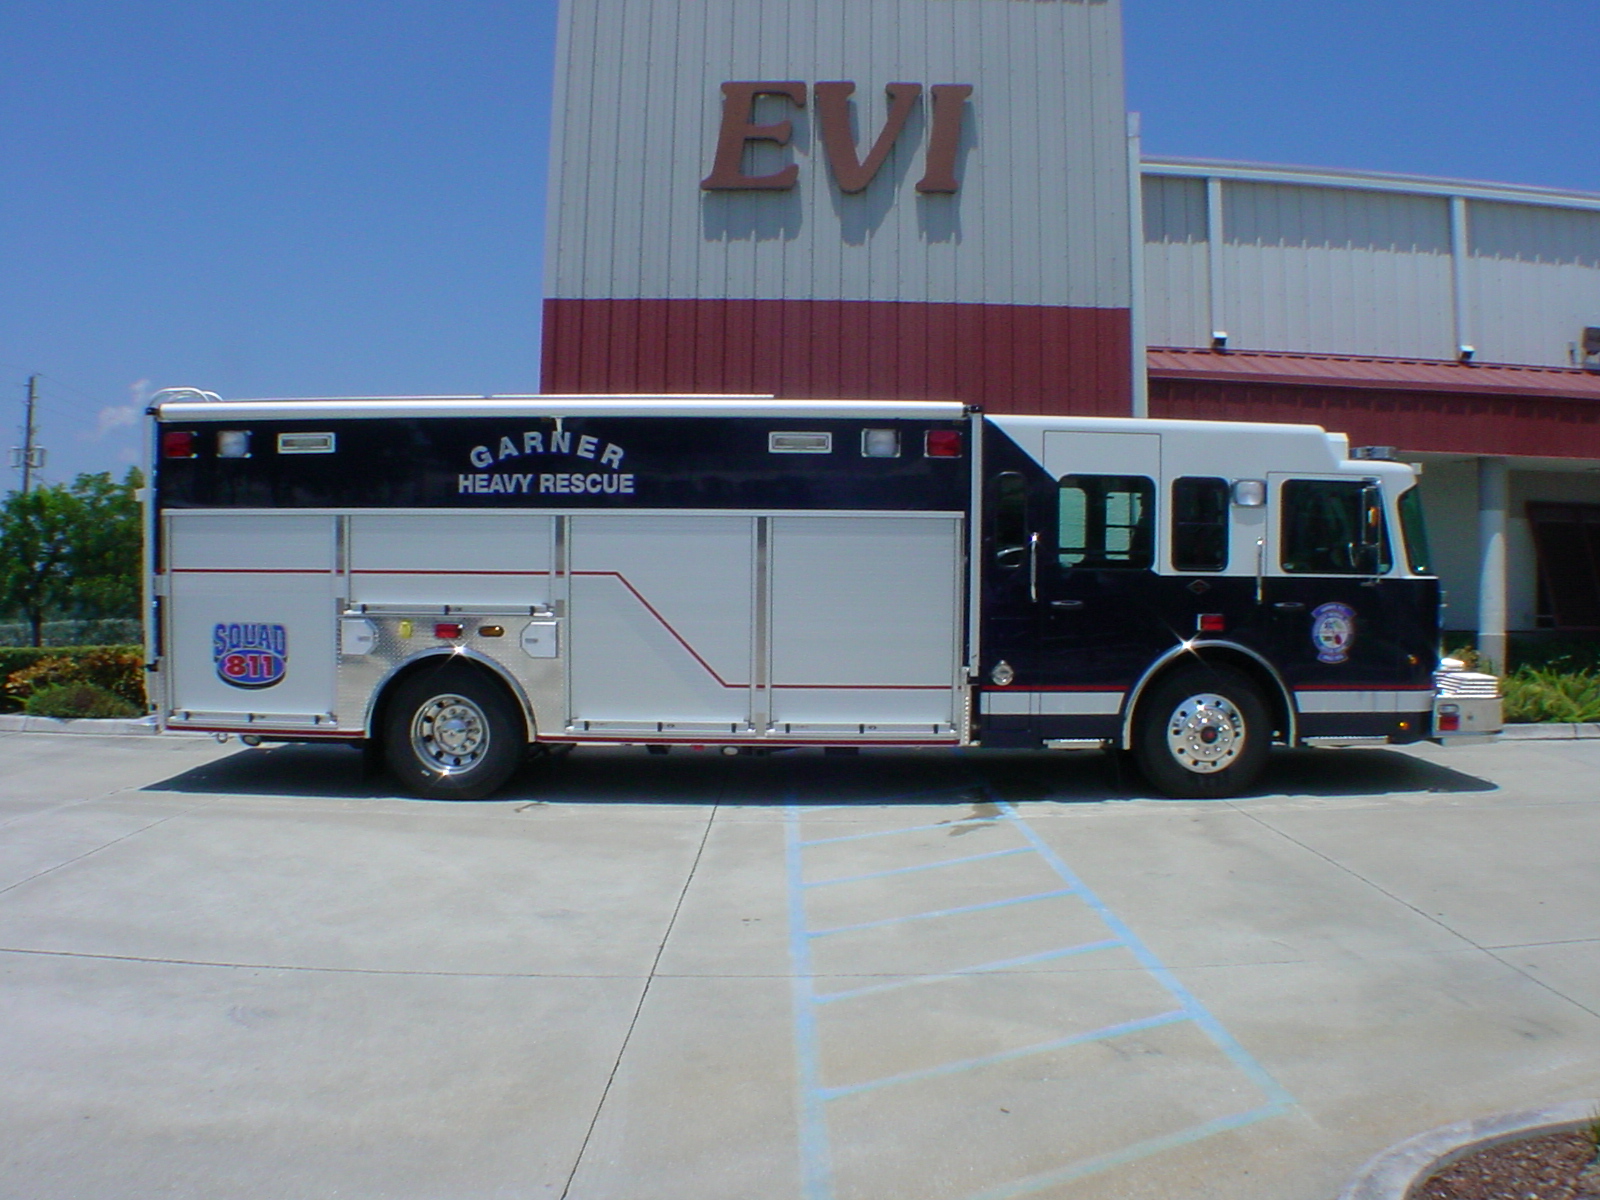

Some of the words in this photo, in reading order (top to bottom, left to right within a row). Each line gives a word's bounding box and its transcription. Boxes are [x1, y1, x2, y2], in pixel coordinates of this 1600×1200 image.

[700, 80, 974, 195] EVI
[470, 431, 625, 470] GARNER
[458, 473, 533, 494] HEAVY
[539, 473, 635, 494] RESCUE
[213, 622, 286, 658] SQUAD
[224, 653, 274, 678] 811
